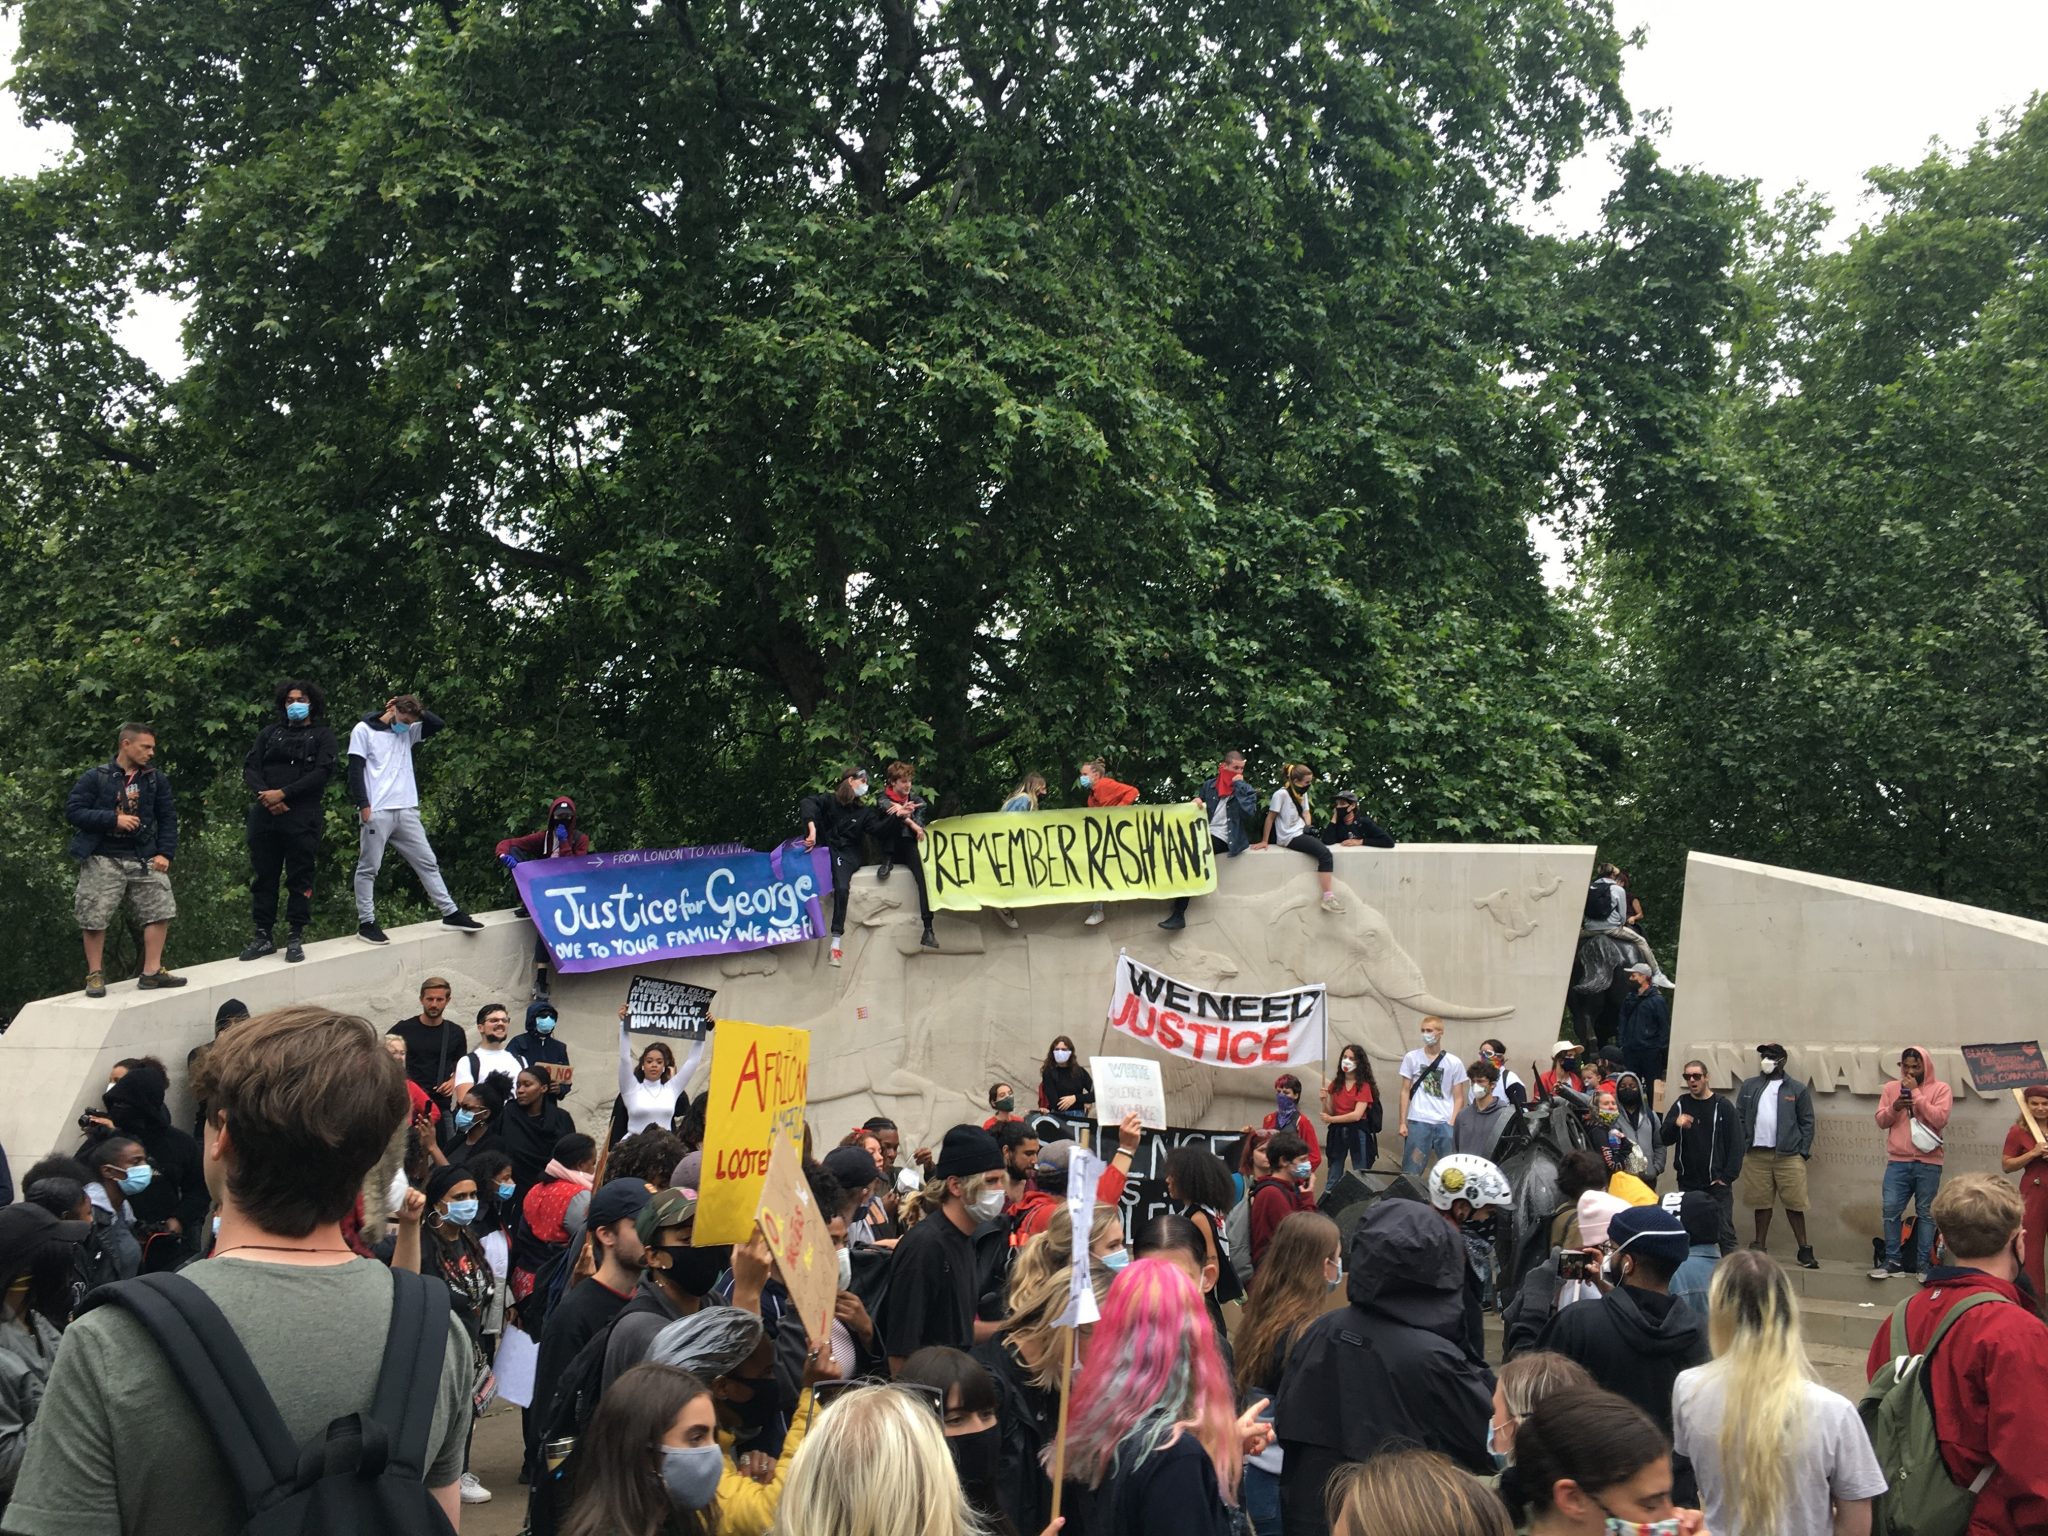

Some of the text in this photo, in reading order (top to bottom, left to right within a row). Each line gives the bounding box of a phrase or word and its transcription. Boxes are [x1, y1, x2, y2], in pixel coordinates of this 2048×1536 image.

[612, 853, 640, 865] FROM
[644, 849, 683, 862] LONDON
[688, 846, 704, 859] TO
[933, 824, 1084, 894] REMEMBER
[679, 888, 706, 920] for
[706, 868, 817, 928] George
[549, 941, 584, 960] OVE
[588, 942, 610, 958] TO
[611, 934, 659, 956] YOUR
[735, 921, 765, 942] WE
[767, 924, 802, 944] ARE
[628, 1001, 669, 1015] KILLED
[671, 1005, 688, 1015] ALL
[1127, 961, 1321, 1023] WE NEED
[1112, 992, 1292, 1065] JUSTICE
